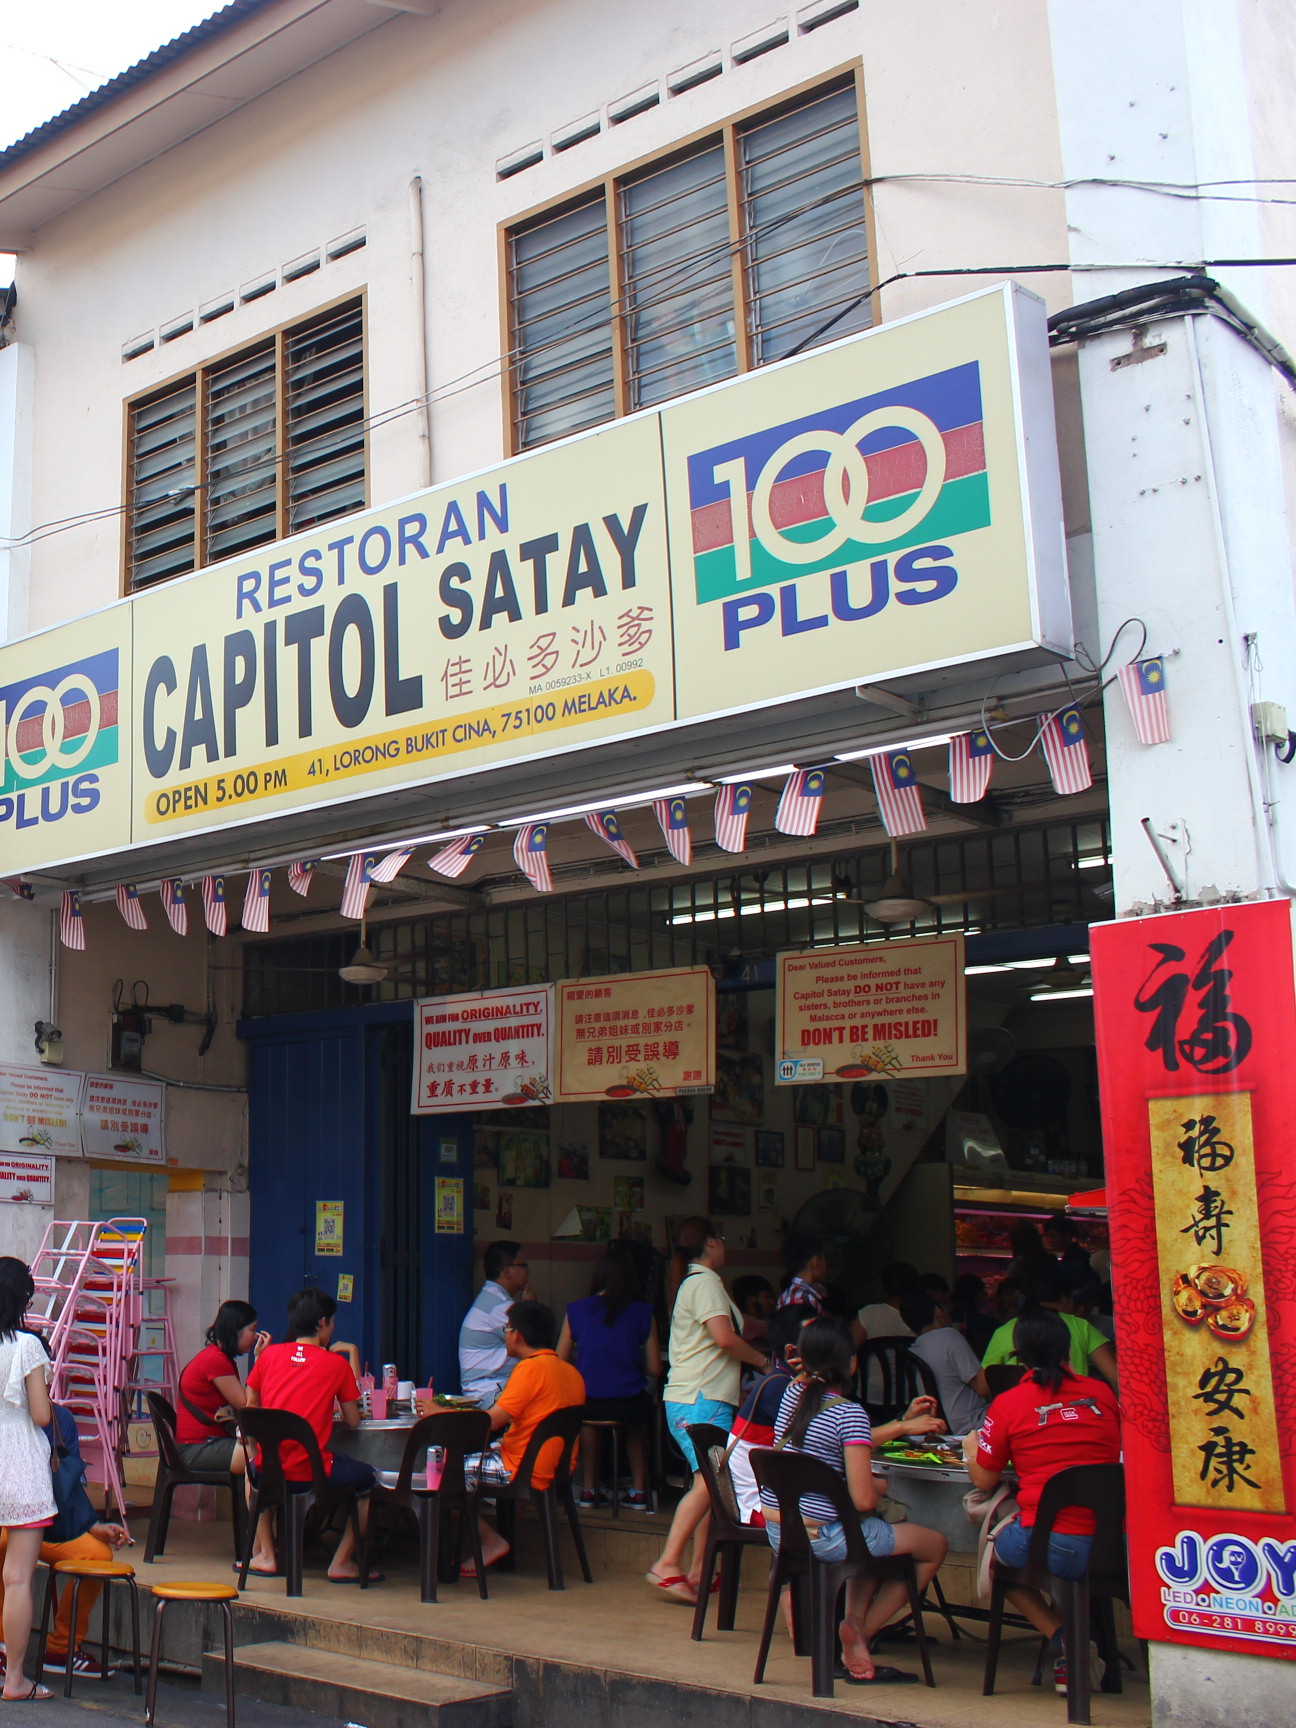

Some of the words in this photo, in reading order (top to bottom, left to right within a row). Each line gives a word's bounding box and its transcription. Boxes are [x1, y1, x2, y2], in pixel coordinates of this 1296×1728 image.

[713, 405, 946, 582] 100
[236, 483, 509, 619] RESTORAN
[722, 545, 958, 651] PLUS
[143, 582, 423, 778] CAPITOL
[438, 502, 649, 640] SATAY
[441, 606, 653, 701] 佳必多沙爹
[529, 685, 543, 695] MA
[545, 671, 592, 691] 0059233-X
[615, 658, 644, 674] 00992
[156, 783, 209, 816] OPEN
[216, 771, 259, 803] 5.00
[264, 768, 288, 791] PM
[307, 758, 330, 778] 41,
[334, 740, 400, 772] LORONG
[405, 729, 447, 755] BUKIT
[452, 718, 497, 743] CINA,
[501, 702, 555, 732] 75100
[562, 684, 637, 717] MELAKA.
[741, 965, 759, 982] 41
[788, 963, 807, 972] Dear
[809, 960, 836, 970] Valued
[838, 956, 886, 967] Customers,
[815, 975, 845, 984] Please
[847, 973, 858, 981] be
[860, 968, 901, 980] informed
[904, 966, 922, 976] that
[793, 989, 825, 1001] Capitol
[826, 988, 851, 999] Satay
[854, 985, 871, 995] DO
[875, 981, 901, 993] NOT
[904, 980, 926, 990] have
[928, 979, 946, 990] any
[798, 1002, 831, 1012] sisters,
[833, 999, 871, 1009] brothers
[885, 994, 929, 1005] branches
[931, 992, 940, 1000] in
[1134, 929, 1253, 1075] 福
[425, 1015, 434, 1025] WE
[435, 1013, 447, 1024] AIM
[448, 1012, 459, 1023] FOR
[461, 1001, 543, 1021] ORIGINALITY,
[809, 1013, 845, 1023] Malacca
[860, 1009, 903, 1020] anywhere
[906, 1005, 928, 1015] else.
[425, 1028, 471, 1050] QUALITY
[472, 1031, 492, 1044] OVER
[493, 1023, 545, 1043] QUANTITY.
[800, 1026, 846, 1047] DON'T
[849, 1024, 869, 1043] BE
[872, 1019, 938, 1041] MISLED!
[587, 1041, 680, 1066] 請別受誤導
[910, 1054, 935, 1063] Thank
[937, 1052, 953, 1061] You
[26, 1115, 37, 1125] BE
[1160, 1535, 1296, 1597] JOY
[1163, 1590, 1194, 1604] LED
[1212, 1596, 1260, 1613] NEON
[1179, 1611, 1242, 1630] 06-281
